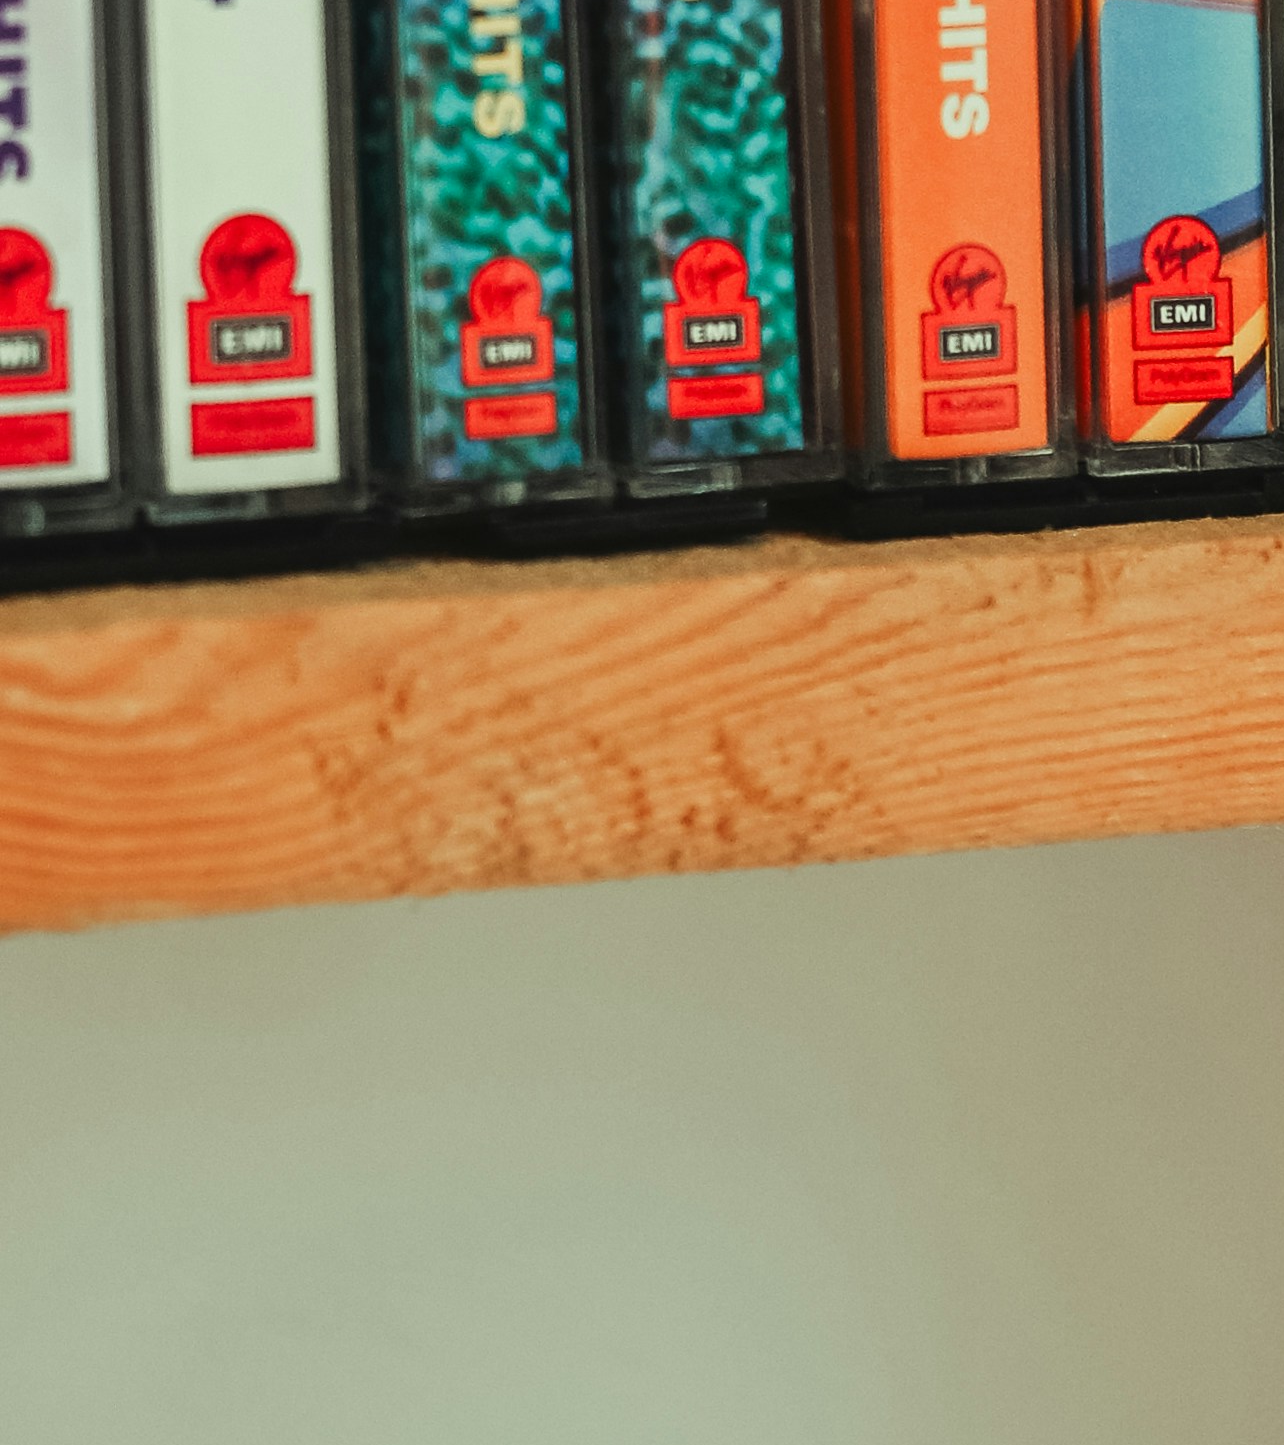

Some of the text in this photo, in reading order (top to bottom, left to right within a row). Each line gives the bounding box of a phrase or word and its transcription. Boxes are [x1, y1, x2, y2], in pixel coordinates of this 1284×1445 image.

[1159, 303, 1207, 325] EMI
[689, 319, 738, 345] EMI
[948, 329, 994, 355] EMI
